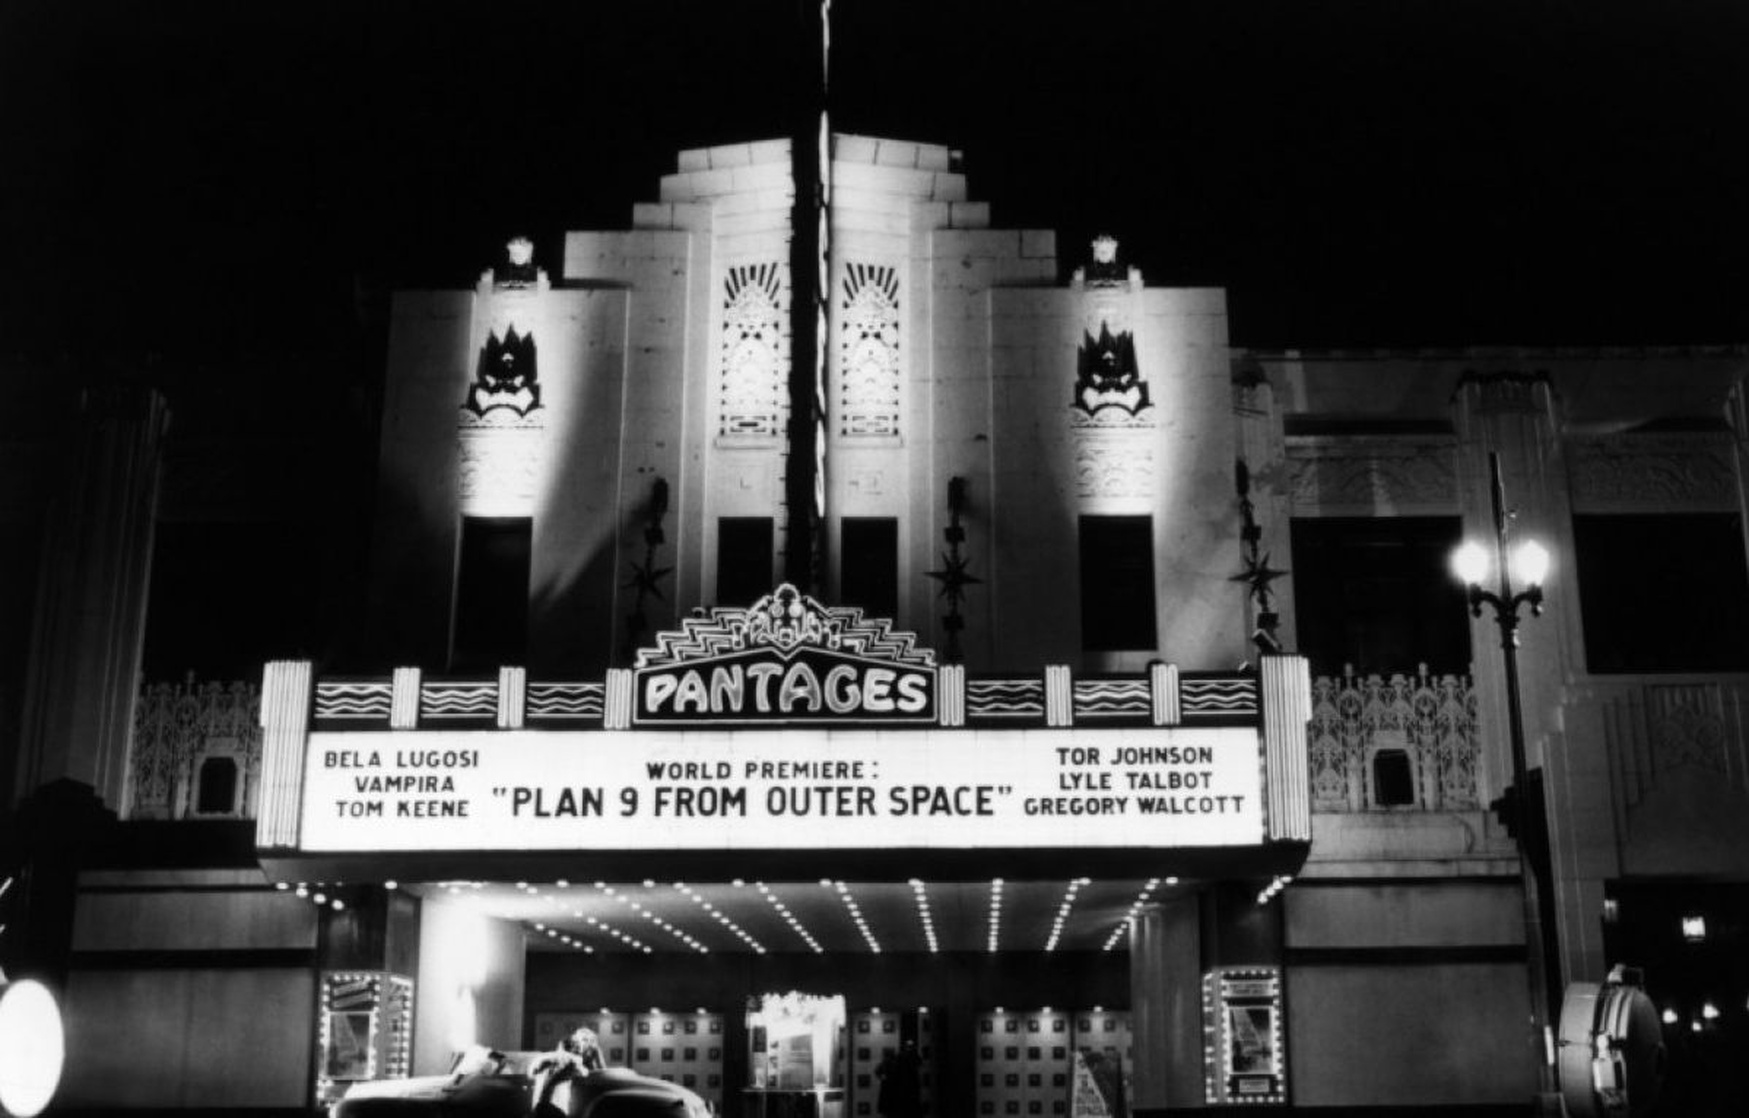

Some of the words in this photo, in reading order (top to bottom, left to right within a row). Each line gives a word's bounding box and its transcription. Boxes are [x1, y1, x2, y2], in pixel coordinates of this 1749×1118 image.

[646, 662, 926, 712] PANTAGES
[324, 751, 381, 768] BELA
[396, 750, 478, 768] LUGOSI
[1056, 747, 1100, 766] TOR
[1110, 746, 1213, 766] JOHNSON
[646, 762, 731, 781] WORLD
[745, 761, 878, 780] PREMIERE:
[1059, 772, 1112, 791] LYLE
[1125, 771, 1212, 790] TALBOT
[355, 775, 455, 793] VAMPIRA
[336, 801, 383, 817] TOM
[397, 800, 468, 818] KEENE
[620, 786, 639, 817] 9
[654, 786, 747, 817] FROM
[766, 786, 877, 817] OUTER
[1024, 797, 1128, 816] GREGORY
[1136, 795, 1244, 815] WALCOTT
